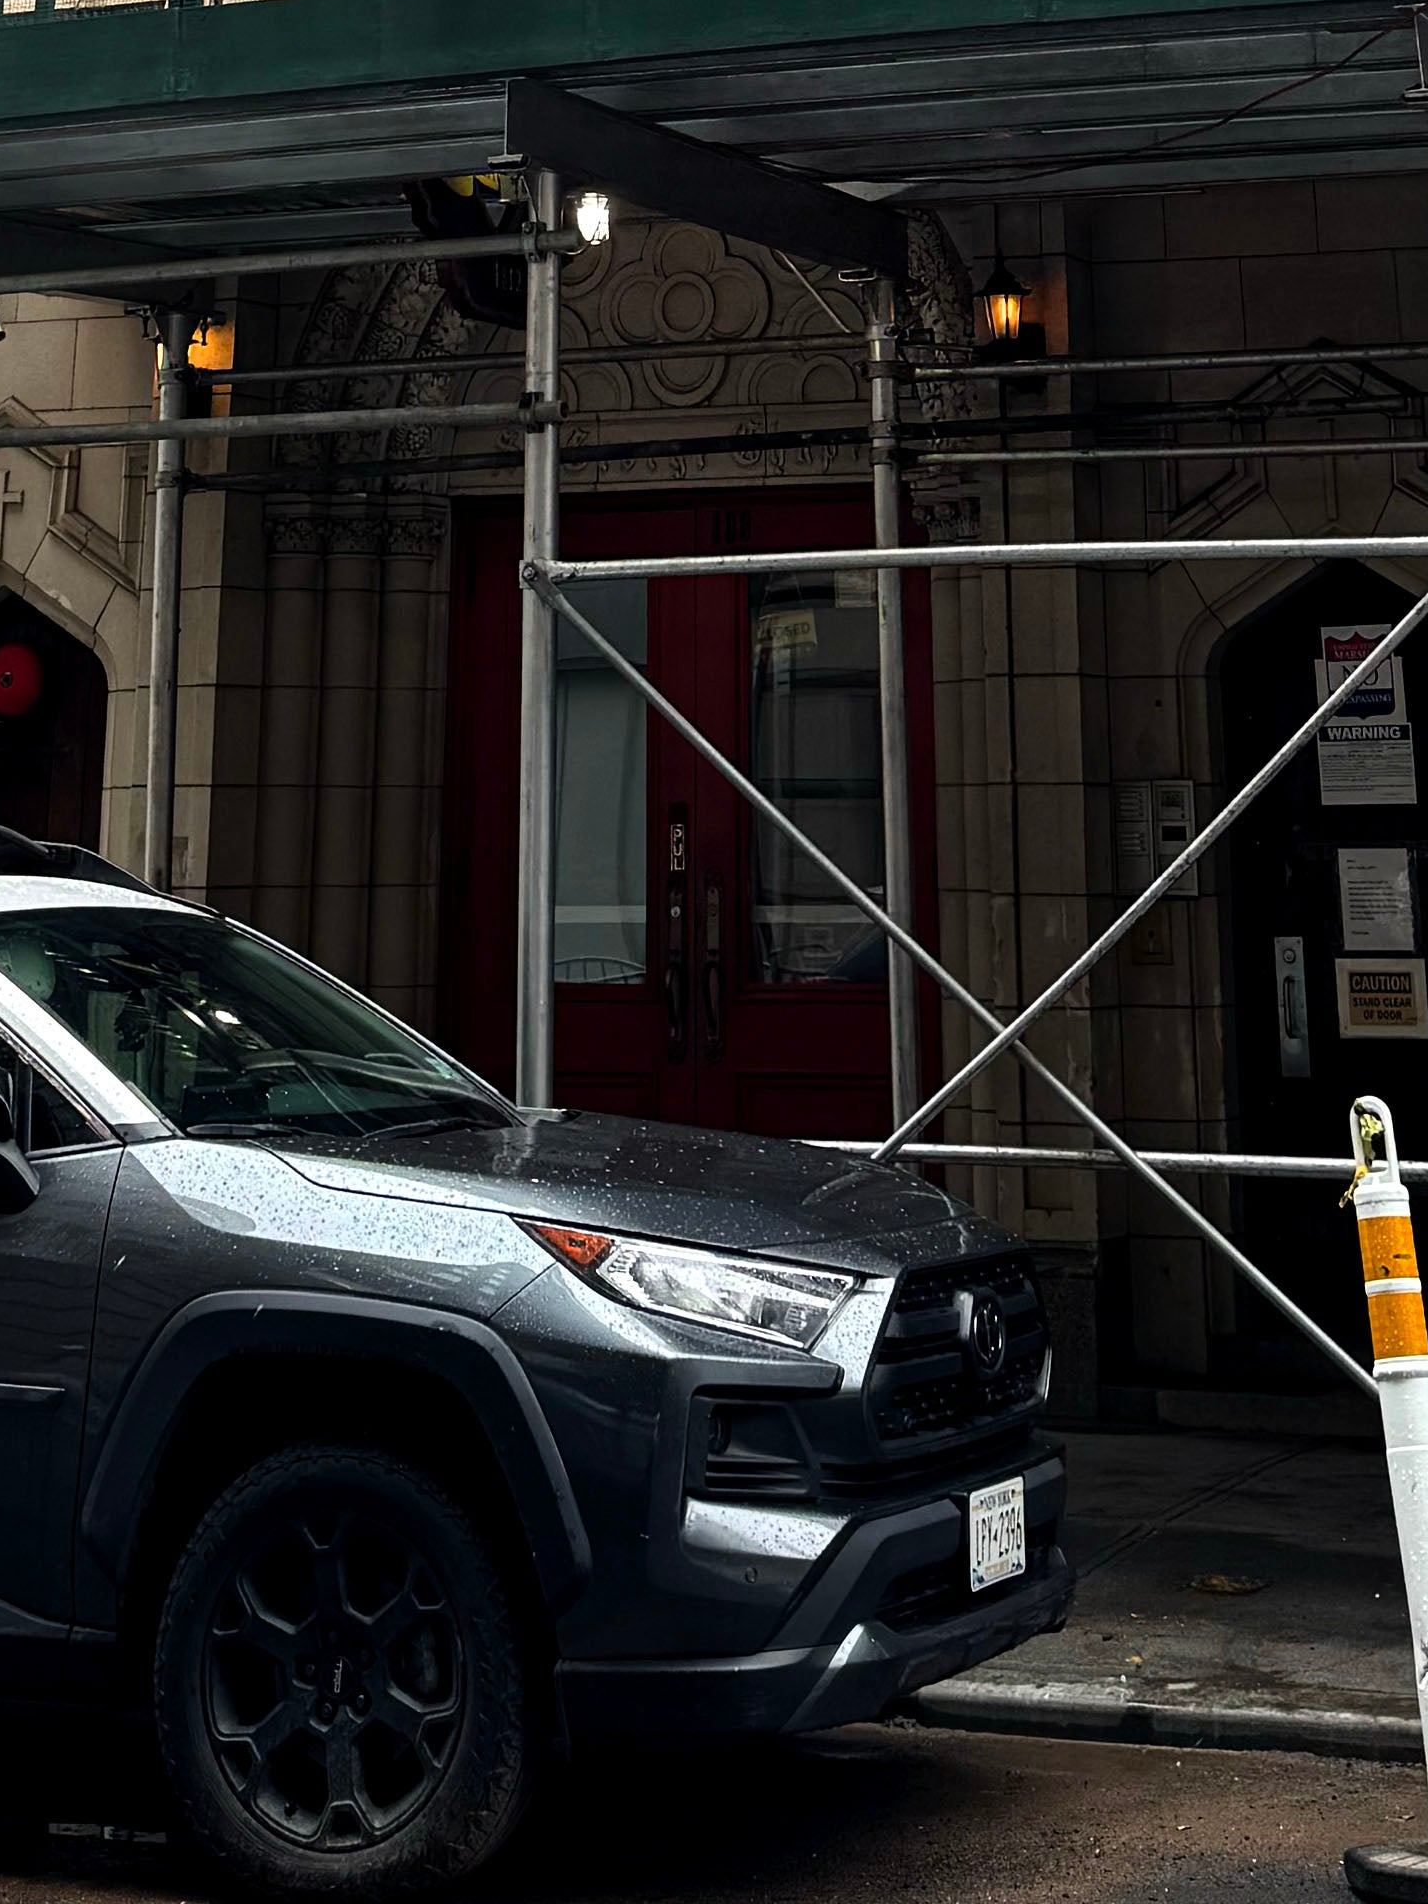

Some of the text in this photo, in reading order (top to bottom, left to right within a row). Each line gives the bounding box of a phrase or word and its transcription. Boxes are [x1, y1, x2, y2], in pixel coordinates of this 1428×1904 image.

[1327, 726, 1401, 740] WARNING
[1352, 976, 1410, 991] CAUTION
[1352, 997, 1412, 1008] STAND CLEAR
[1363, 1010, 1402, 1020] OF DOOR
